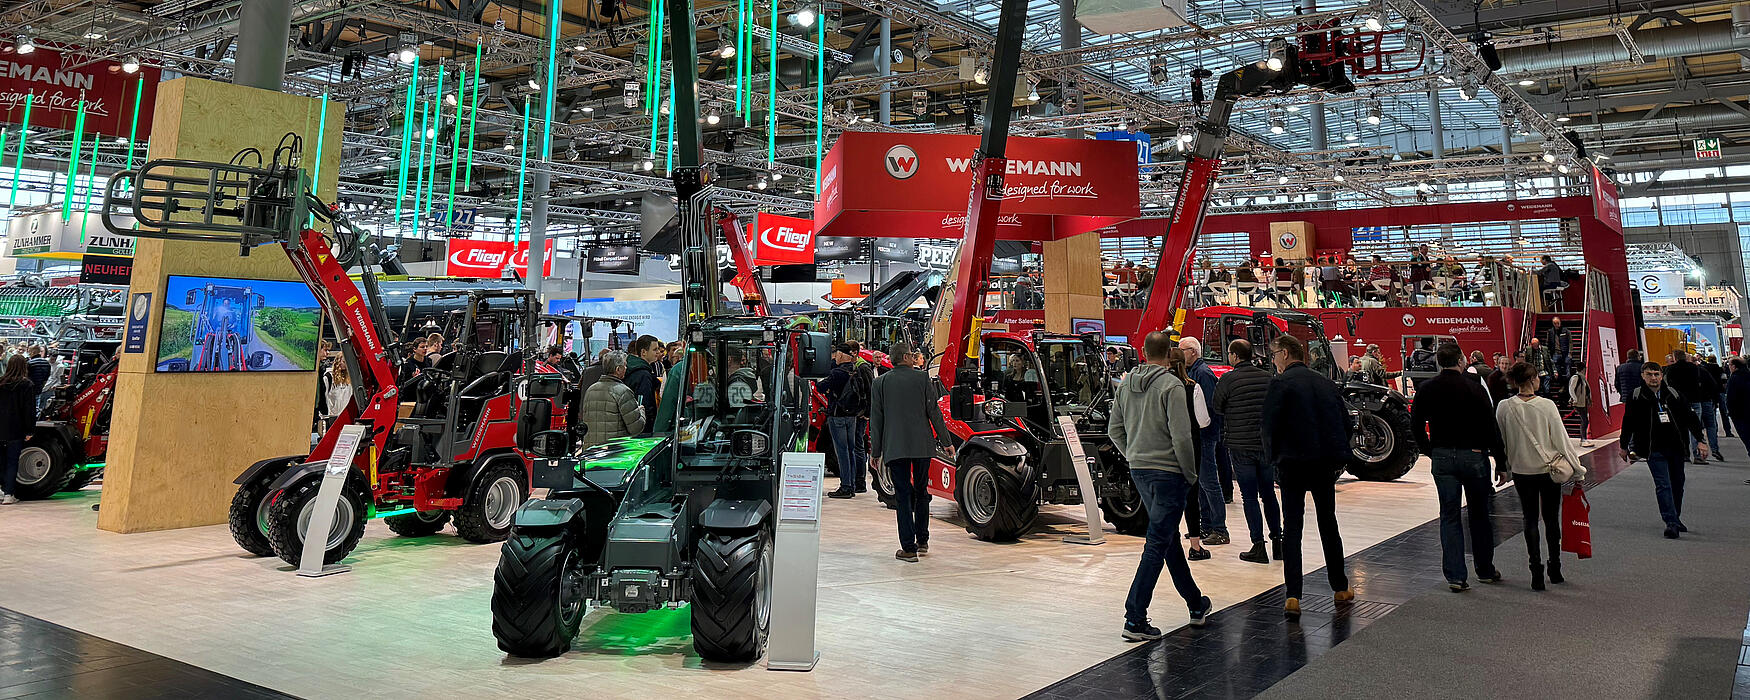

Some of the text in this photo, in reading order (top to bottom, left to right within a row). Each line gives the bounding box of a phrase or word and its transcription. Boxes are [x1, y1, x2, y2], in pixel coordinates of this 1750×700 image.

[48, 91, 70, 112] for
[1137, 139, 1149, 165] 27
[945, 157, 1082, 177] WEMANN
[1000, 179, 1099, 203] designed for work
[1172, 168, 1194, 224] WEIDEMANN
[455, 209, 473, 226] 27
[941, 213, 967, 231] desig
[13, 235, 52, 249] ZUNHAMMER
[89, 236, 136, 249] ZUNH
[776, 226, 812, 249] Fliegl
[467, 248, 507, 266] Fliegl
[1680, 297, 1726, 305] TRIOIET
[354, 307, 376, 350] WEIDEMANN
[1449, 325, 1470, 334] designed
